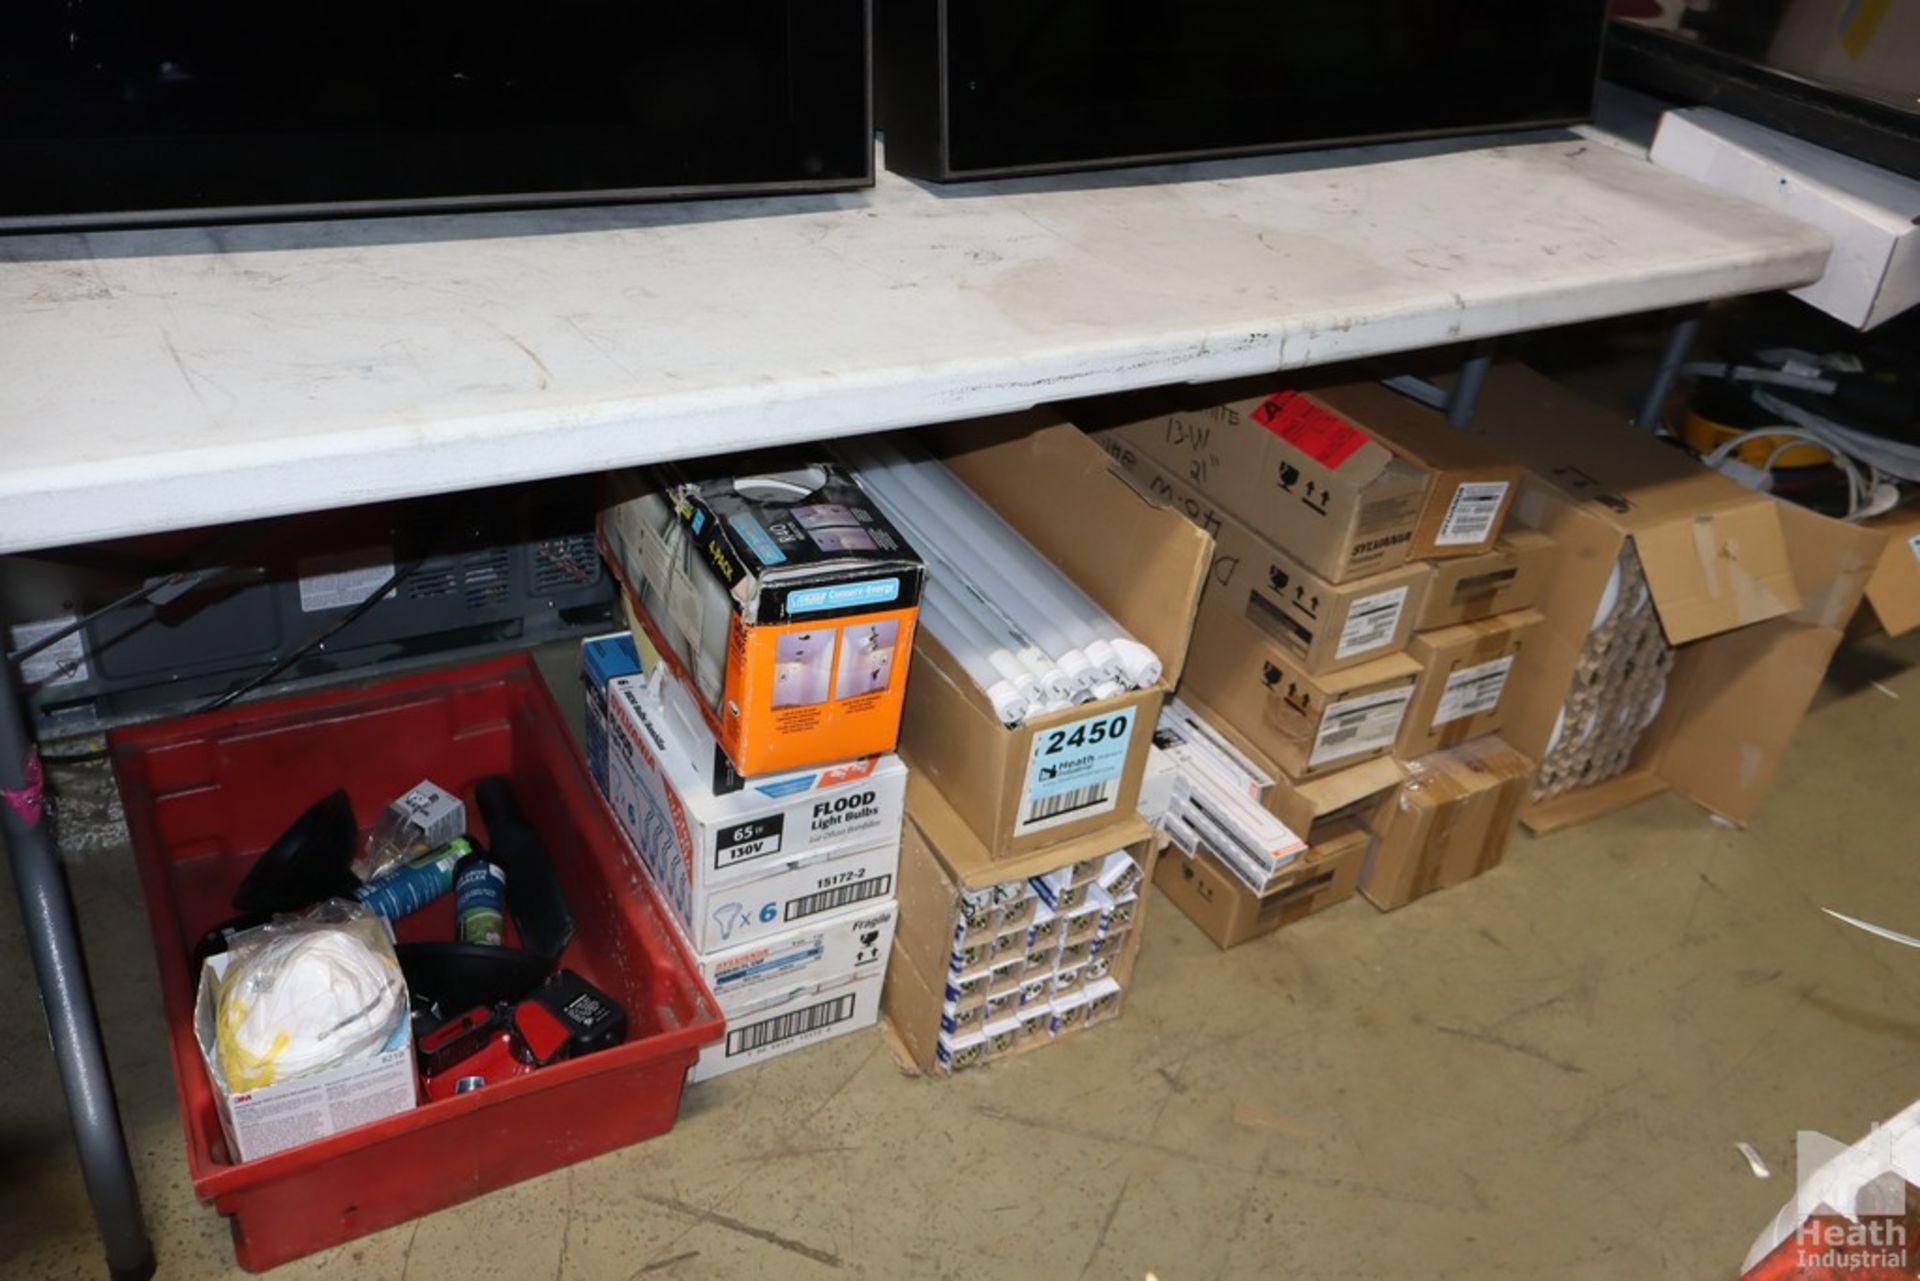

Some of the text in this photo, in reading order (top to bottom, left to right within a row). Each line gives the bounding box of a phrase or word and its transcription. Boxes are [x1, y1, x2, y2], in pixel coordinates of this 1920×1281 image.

[1044, 715, 1128, 756] 2450
[1058, 755, 1095, 770] Heath
[812, 790, 877, 818] FLOOD
[811, 806, 879, 831] Light Bulbs
[733, 824, 753, 843] 65
[730, 841, 764, 860] 130V
[816, 867, 867, 889] 15172-2
[758, 901, 778, 923] 6
[852, 912, 892, 932] Fragile
